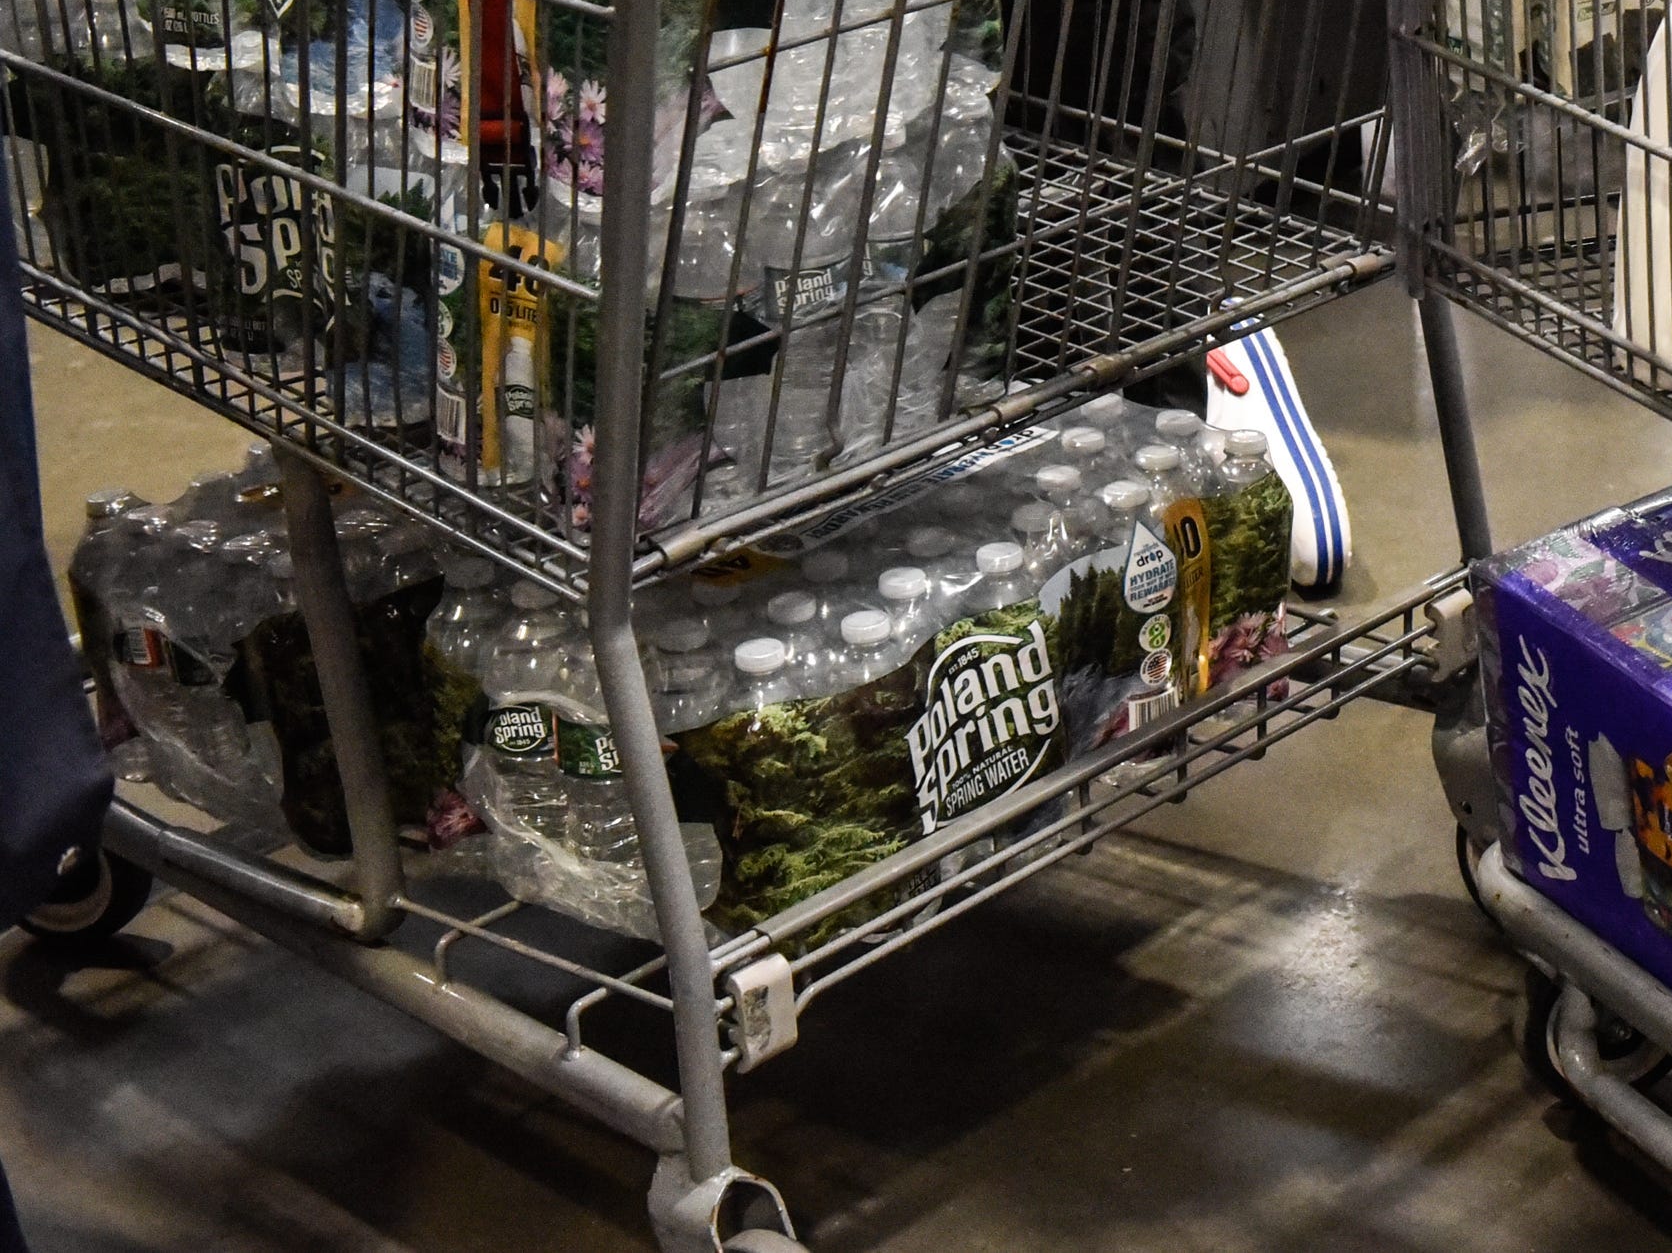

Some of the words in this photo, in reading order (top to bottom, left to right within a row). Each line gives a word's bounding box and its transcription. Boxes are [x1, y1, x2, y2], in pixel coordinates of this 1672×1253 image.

[775, 269, 832, 297] Pland
[516, 305, 538, 324] LITE
[1129, 558, 1175, 587] HYDRATE
[1136, 548, 1164, 568] drop
[956, 647, 979, 667] 1845
[499, 705, 543, 727] oland
[494, 722, 546, 745] Spring
[916, 678, 1060, 836] Spring
[972, 745, 1014, 775] NATURAL
[1517, 634, 1578, 881] Kleenex
[1565, 724, 1585, 783] soft
[945, 775, 984, 818] SPRING
[984, 747, 1030, 790] WATER
[1573, 787, 1591, 856] ultra
